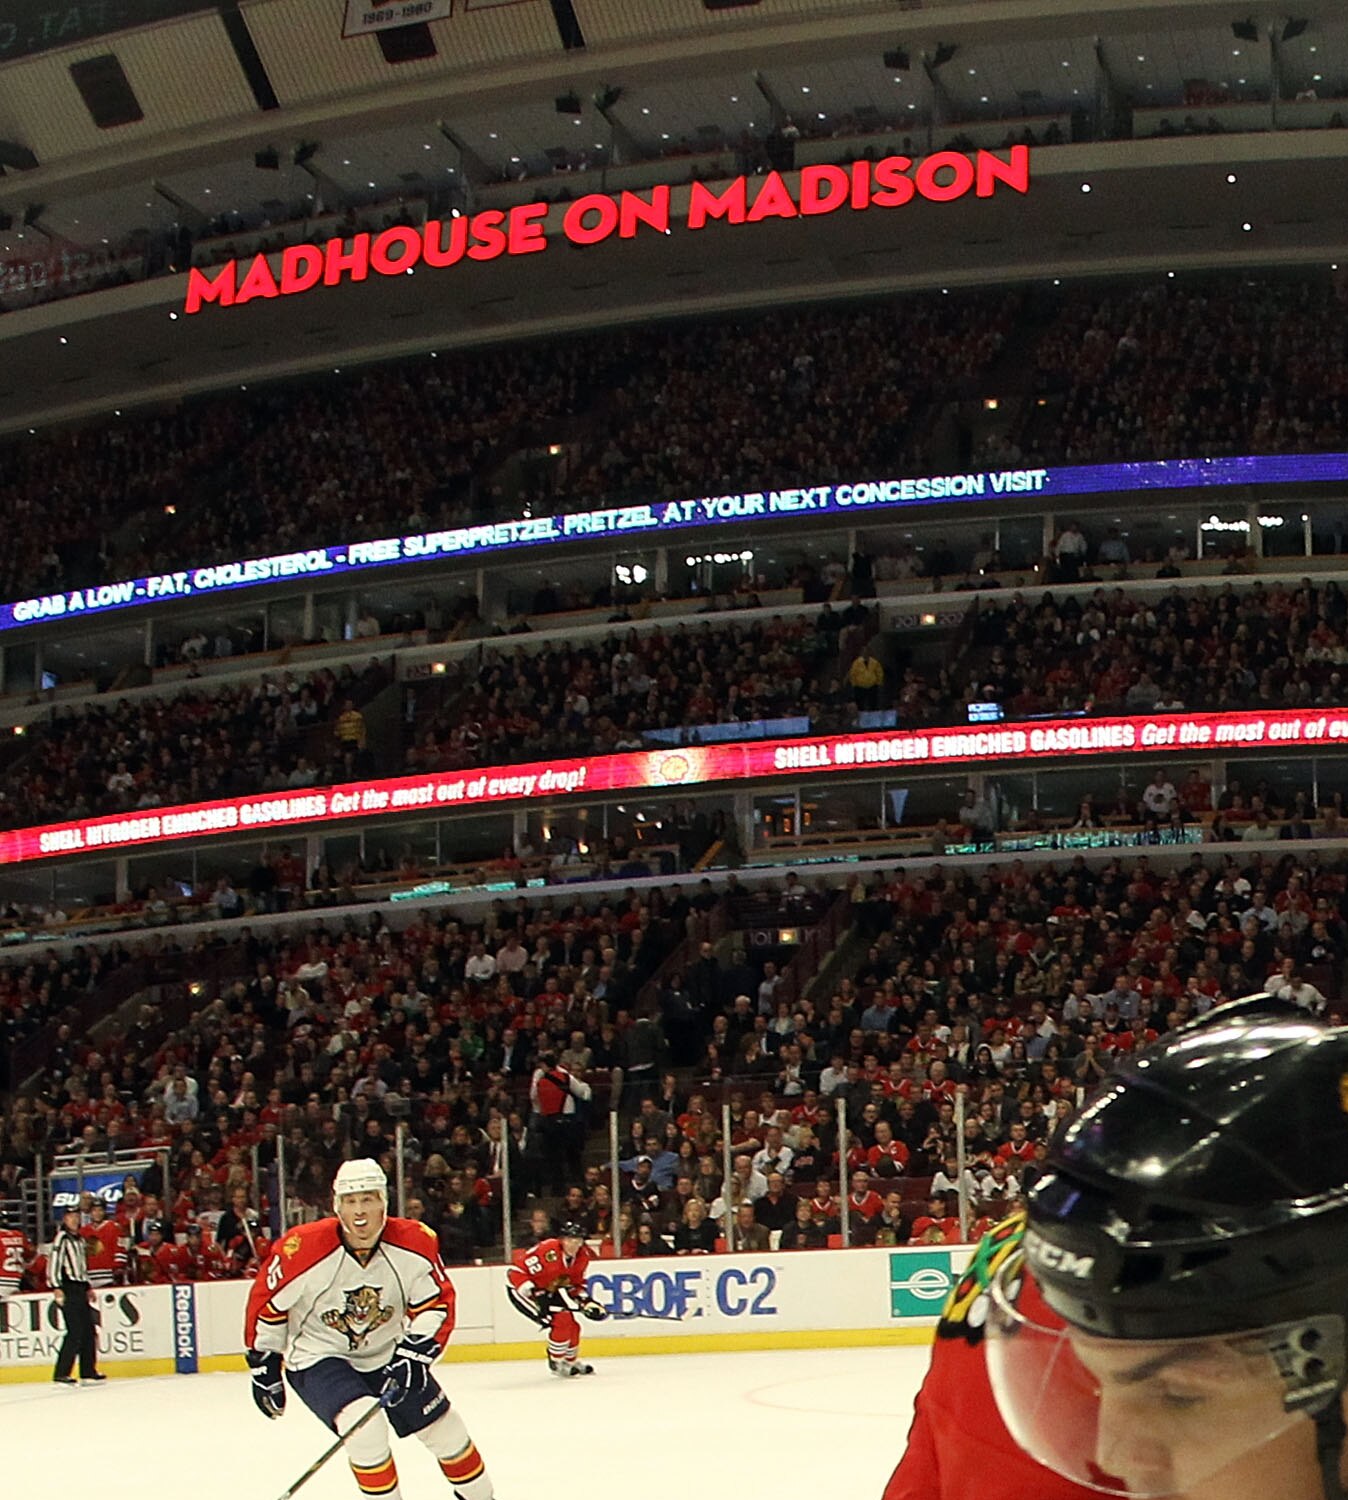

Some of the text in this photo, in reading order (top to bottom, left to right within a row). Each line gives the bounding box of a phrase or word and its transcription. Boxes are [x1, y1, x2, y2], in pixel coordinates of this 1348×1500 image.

[185, 190, 548, 314] MADHOUSE
[563, 183, 670, 246] ON
[687, 144, 1029, 230] MADISON
[14, 594, 67, 622] GRAB
[68, 591, 86, 612] A
[87, 581, 134, 608] LOW
[147, 572, 192, 597] FAT,
[193, 549, 333, 589] CHOLESTEROL
[348, 538, 401, 565] FREE
[402, 517, 561, 557] SUPERPRETZEL
[563, 505, 659, 536] PRETZEL
[663, 500, 697, 524] AT
[701, 493, 764, 519] YOUR
[769, 486, 832, 512] NEXT
[835, 473, 985, 506] CONCESSION
[989, 469, 1046, 493] VISIT
[773, 744, 832, 769] SHELL
[834, 737, 929, 764] NITROGEN
[931, 731, 1027, 758] ENRICHED
[1029, 724, 1135, 752] GASOLINES
[1140, 723, 1177, 745] Get
[1178, 721, 1212, 744] the
[1214, 719, 1266, 742] most
[1268, 718, 1302, 740] out
[1304, 716, 1327, 739] of
[39, 766, 587, 853] SHELL NITROGEN ENRICHED GASOLINES Get the most out of every drop!
[175, 1284, 195, 1359] Reebok
[586, 1266, 778, 1320] CBOE C2
